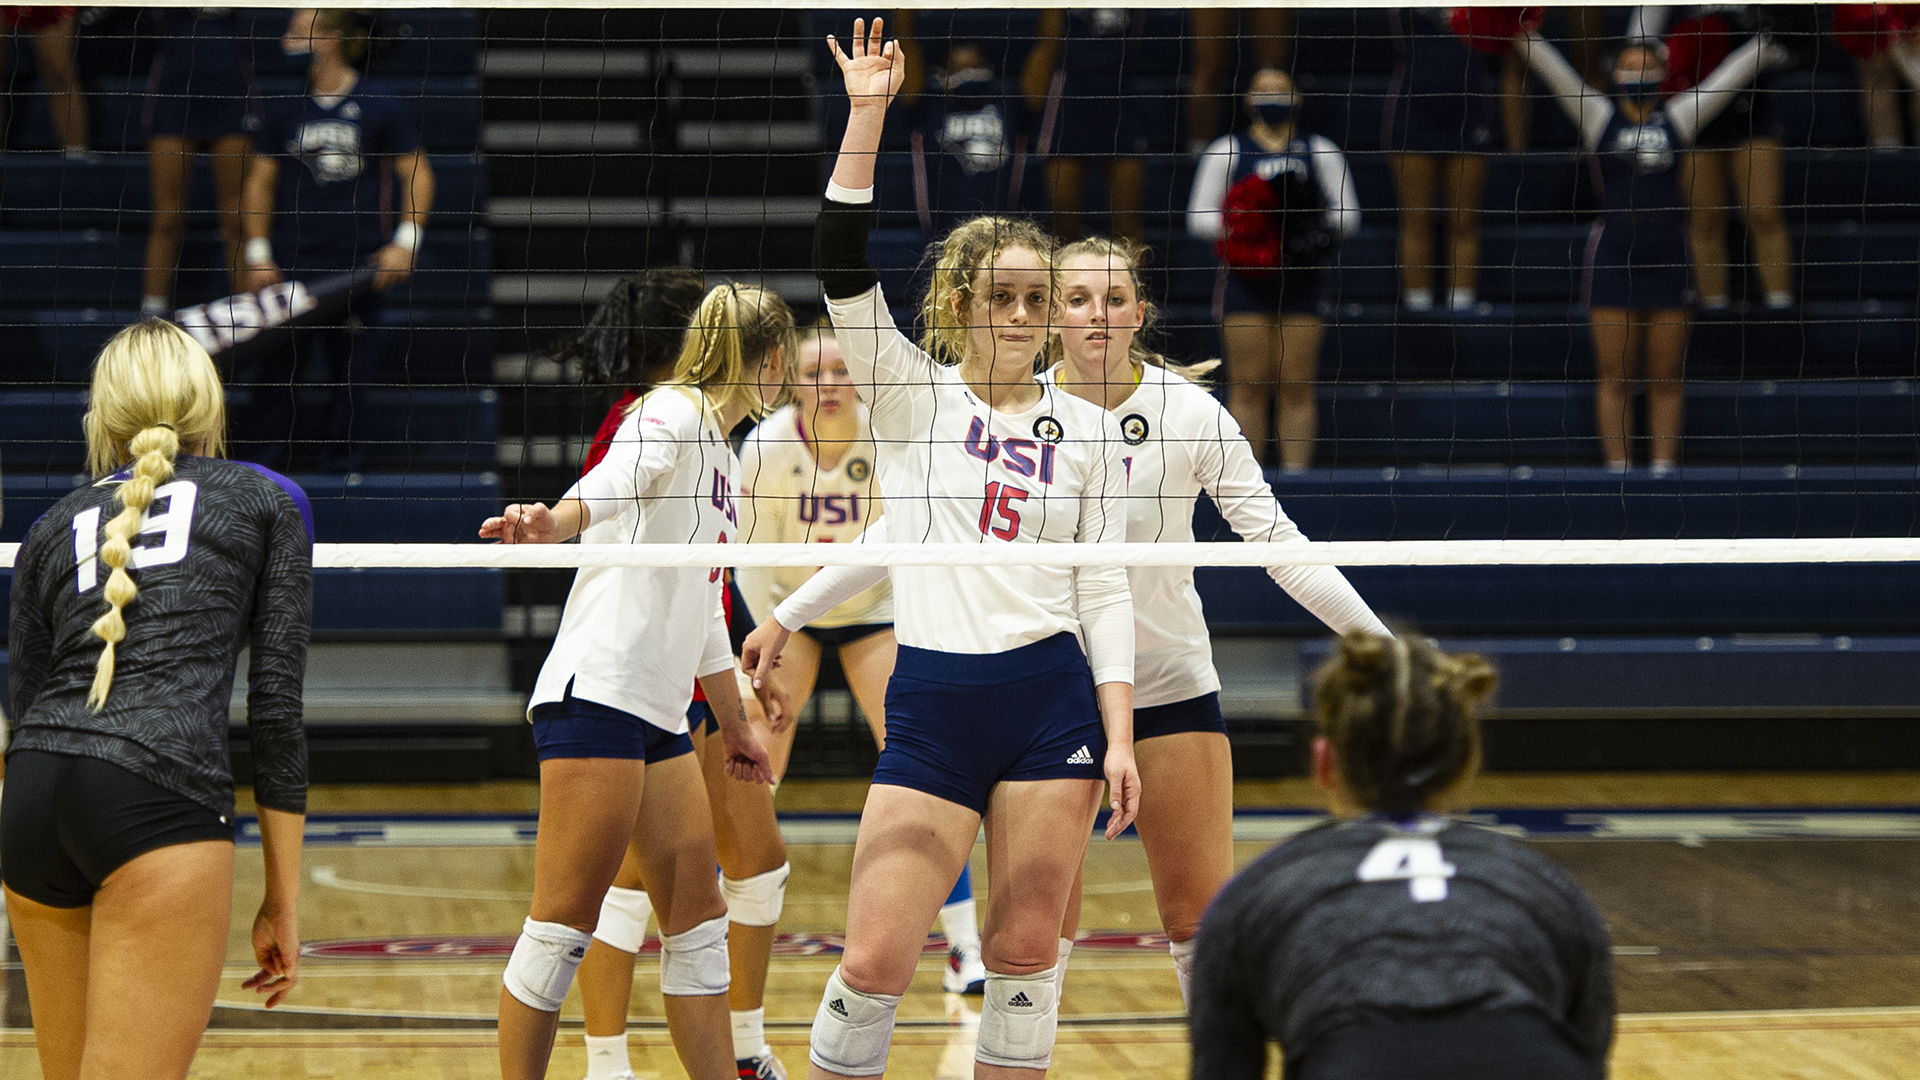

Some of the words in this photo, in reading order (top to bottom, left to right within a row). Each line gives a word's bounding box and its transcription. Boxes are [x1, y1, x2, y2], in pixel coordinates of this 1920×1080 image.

[964, 415, 1056, 486] USI
[799, 492, 860, 524] USI
[978, 480, 1029, 542] 15
[1066, 756, 1094, 764] adidas
[1356, 838, 1458, 903] 4
[1007, 1000, 1033, 1008] adidas
